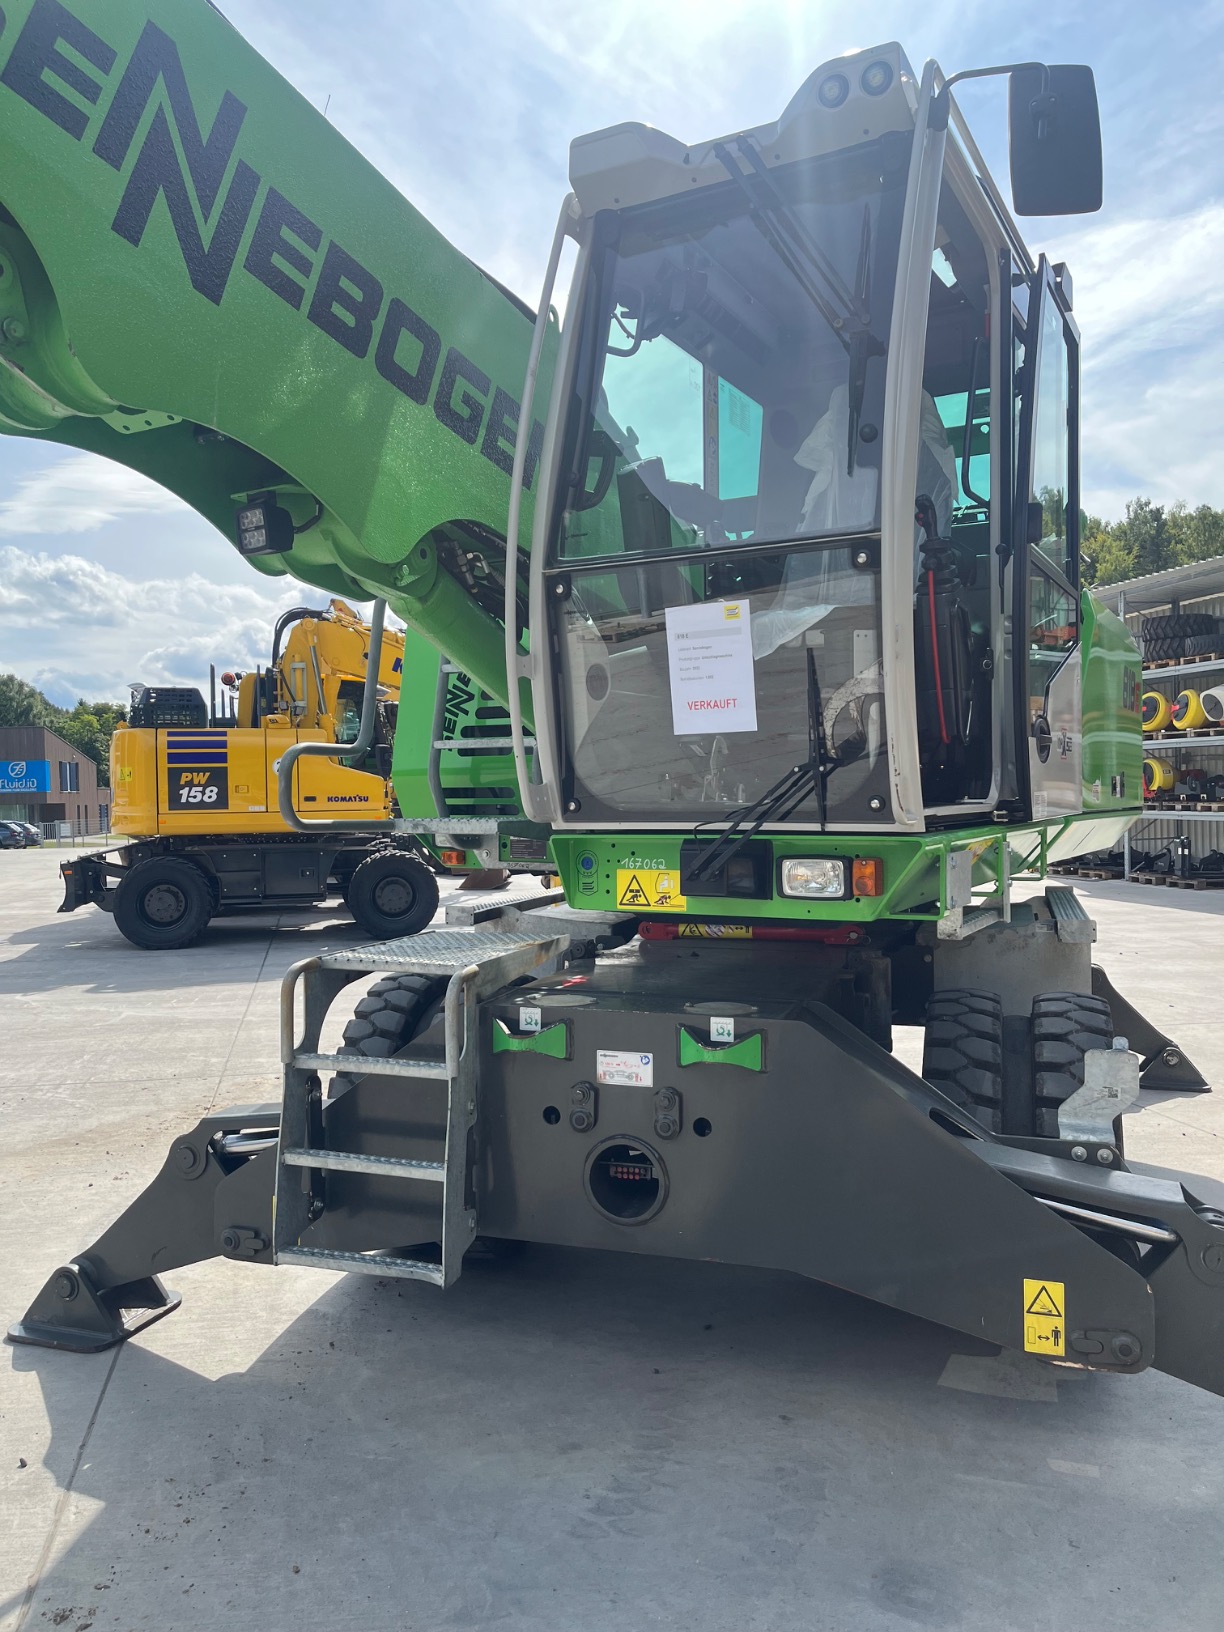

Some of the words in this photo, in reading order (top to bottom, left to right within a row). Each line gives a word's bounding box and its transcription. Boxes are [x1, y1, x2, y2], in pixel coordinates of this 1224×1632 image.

[0, 0, 545, 491] ENNEBOGE
[687, 698, 737, 711] VERKAUFT
[179, 772, 210, 785] PW
[179, 786, 218, 803] 158
[327, 794, 369, 803] KOMATSU
[621, 857, 667, 869] 167062
